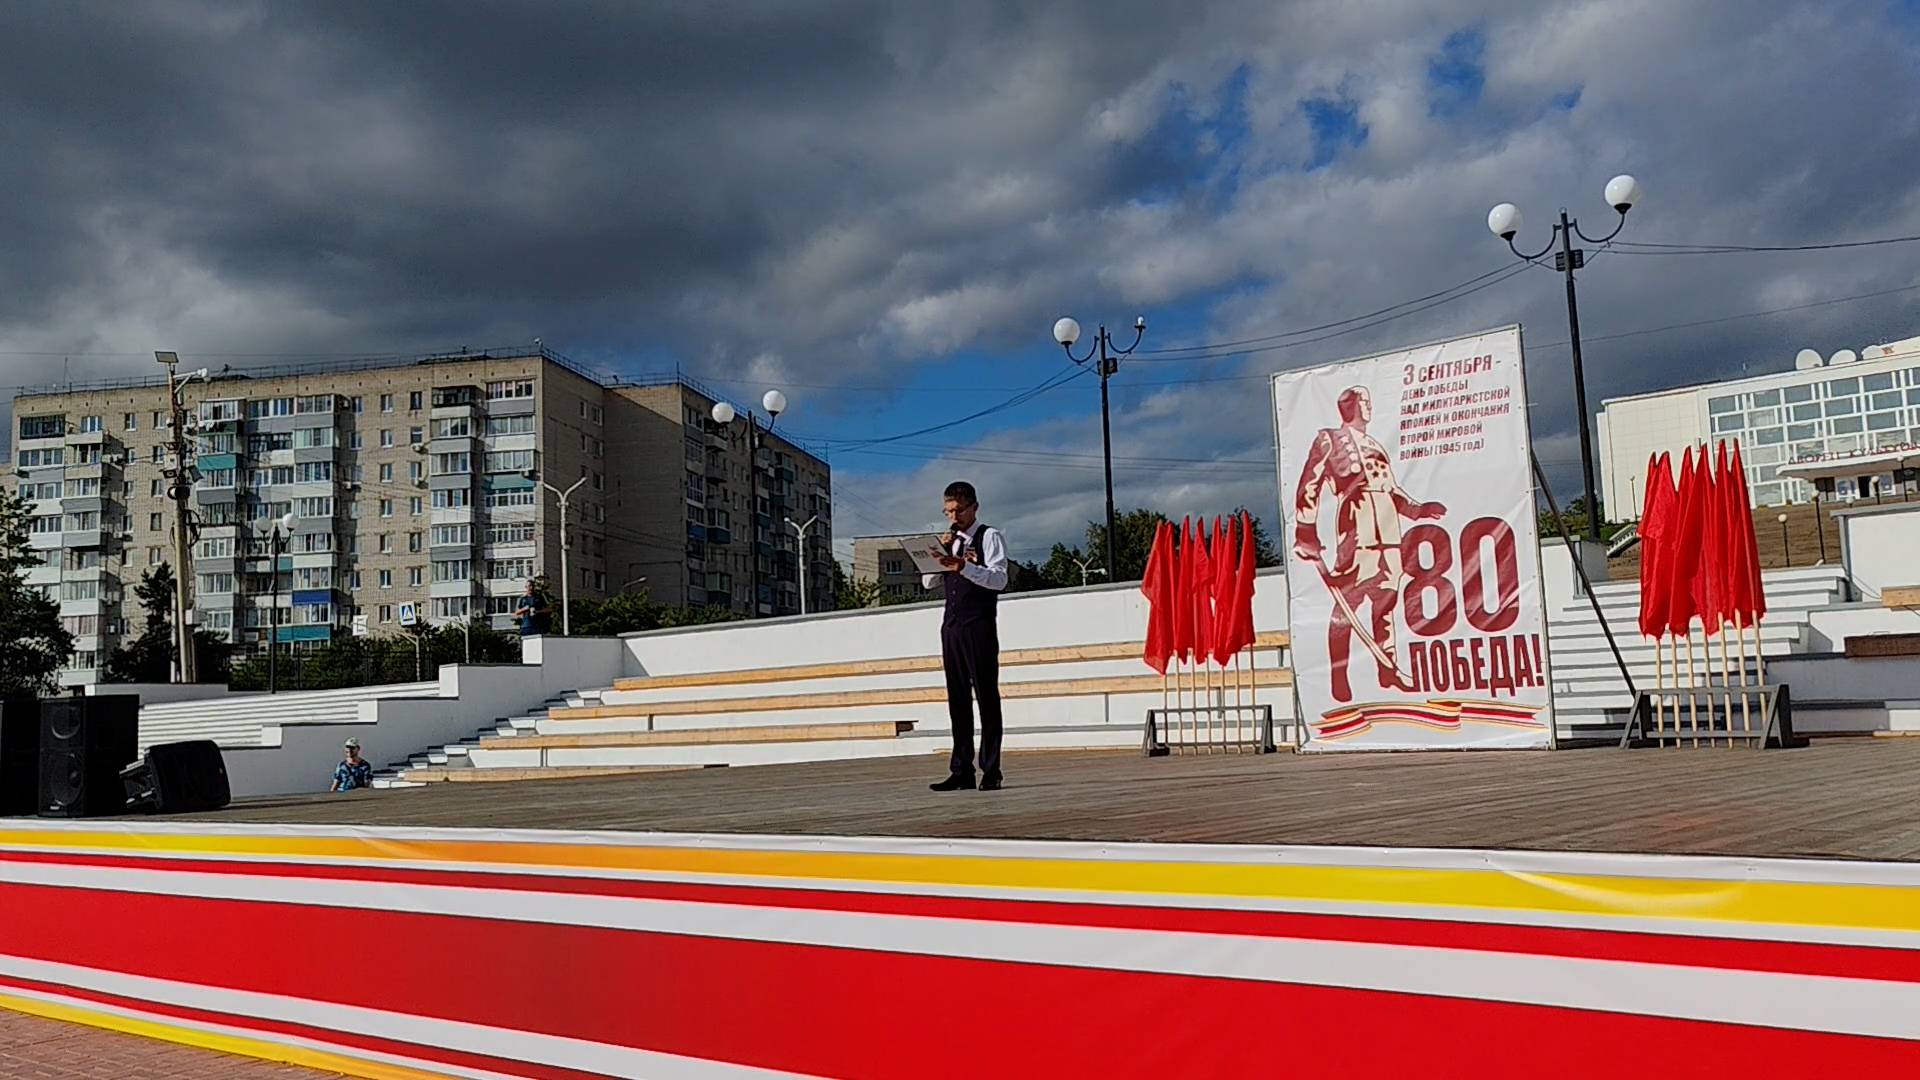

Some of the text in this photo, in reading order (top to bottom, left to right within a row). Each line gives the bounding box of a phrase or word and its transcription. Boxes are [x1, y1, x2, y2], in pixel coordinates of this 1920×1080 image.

[1403, 364, 1415, 386] 3
[1418, 354, 1493, 383] СЕНТЯБРЯ
[1400, 384, 1511, 416] НАД МИЛИТАРИСТСКОЙ
[1401, 379, 1469, 402] ДЕНЬ ПОБЕДЫ
[1400, 402, 1510, 431] ЯПОНИЕЙ И ОКОНЧАНИЯ
[1400, 419, 1483, 446] ВТОРОЙ МИРОВОЙ
[1399, 445, 1433, 461] ВОЙНЫ
[1788, 451, 1840, 465] ДВОРЕЦ
[1400, 516, 1520, 636] 80
[1409, 634, 1544, 697] ПОБЕДА!
